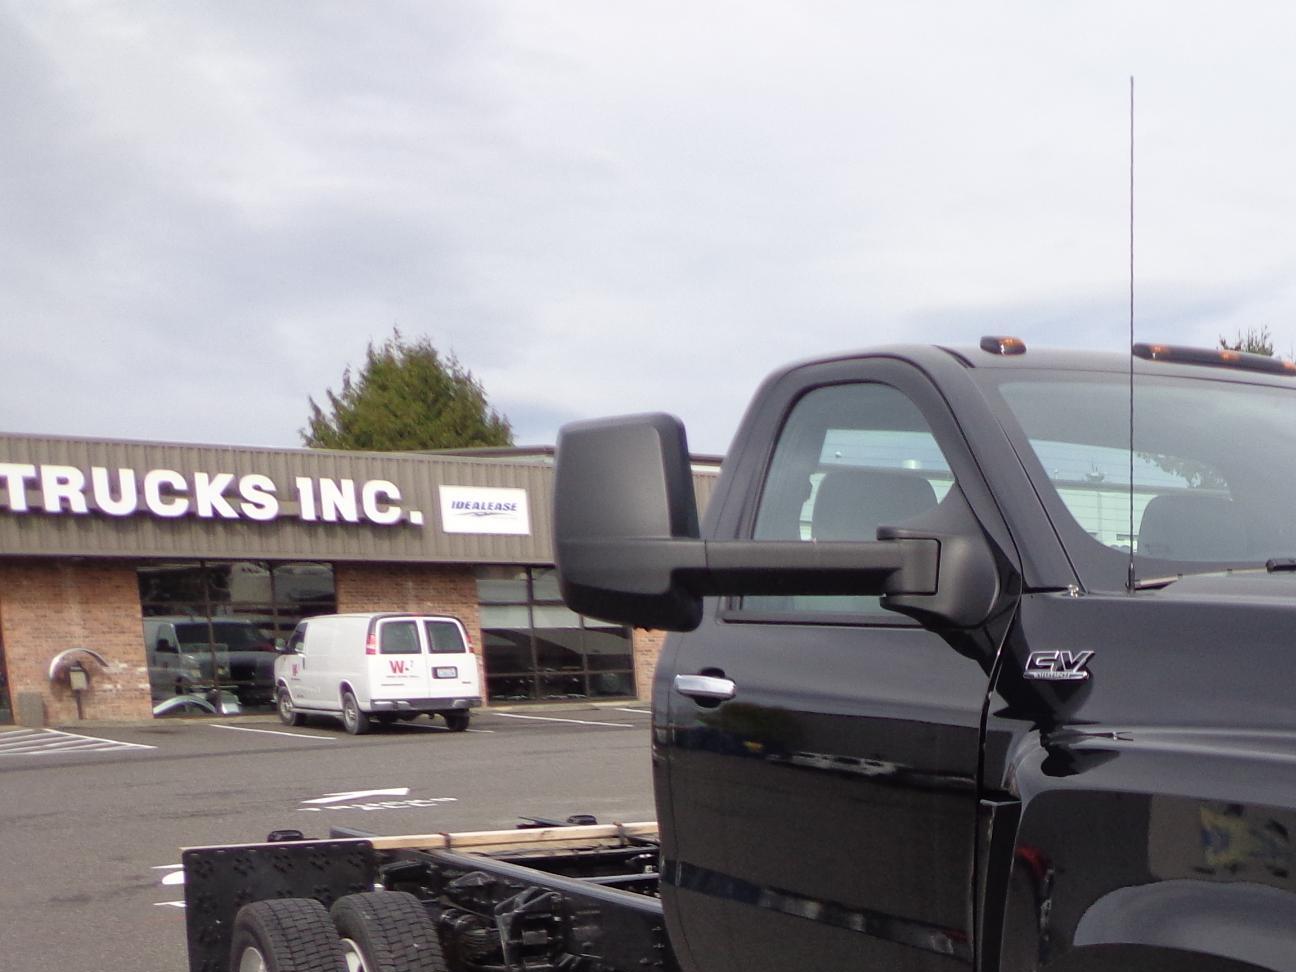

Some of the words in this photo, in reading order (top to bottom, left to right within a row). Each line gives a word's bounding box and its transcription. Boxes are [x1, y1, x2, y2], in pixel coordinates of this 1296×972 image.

[0, 463, 280, 521] TRUCKS
[296, 476, 423, 526] INC.
[451, 500, 518, 512] IDEALEASE
